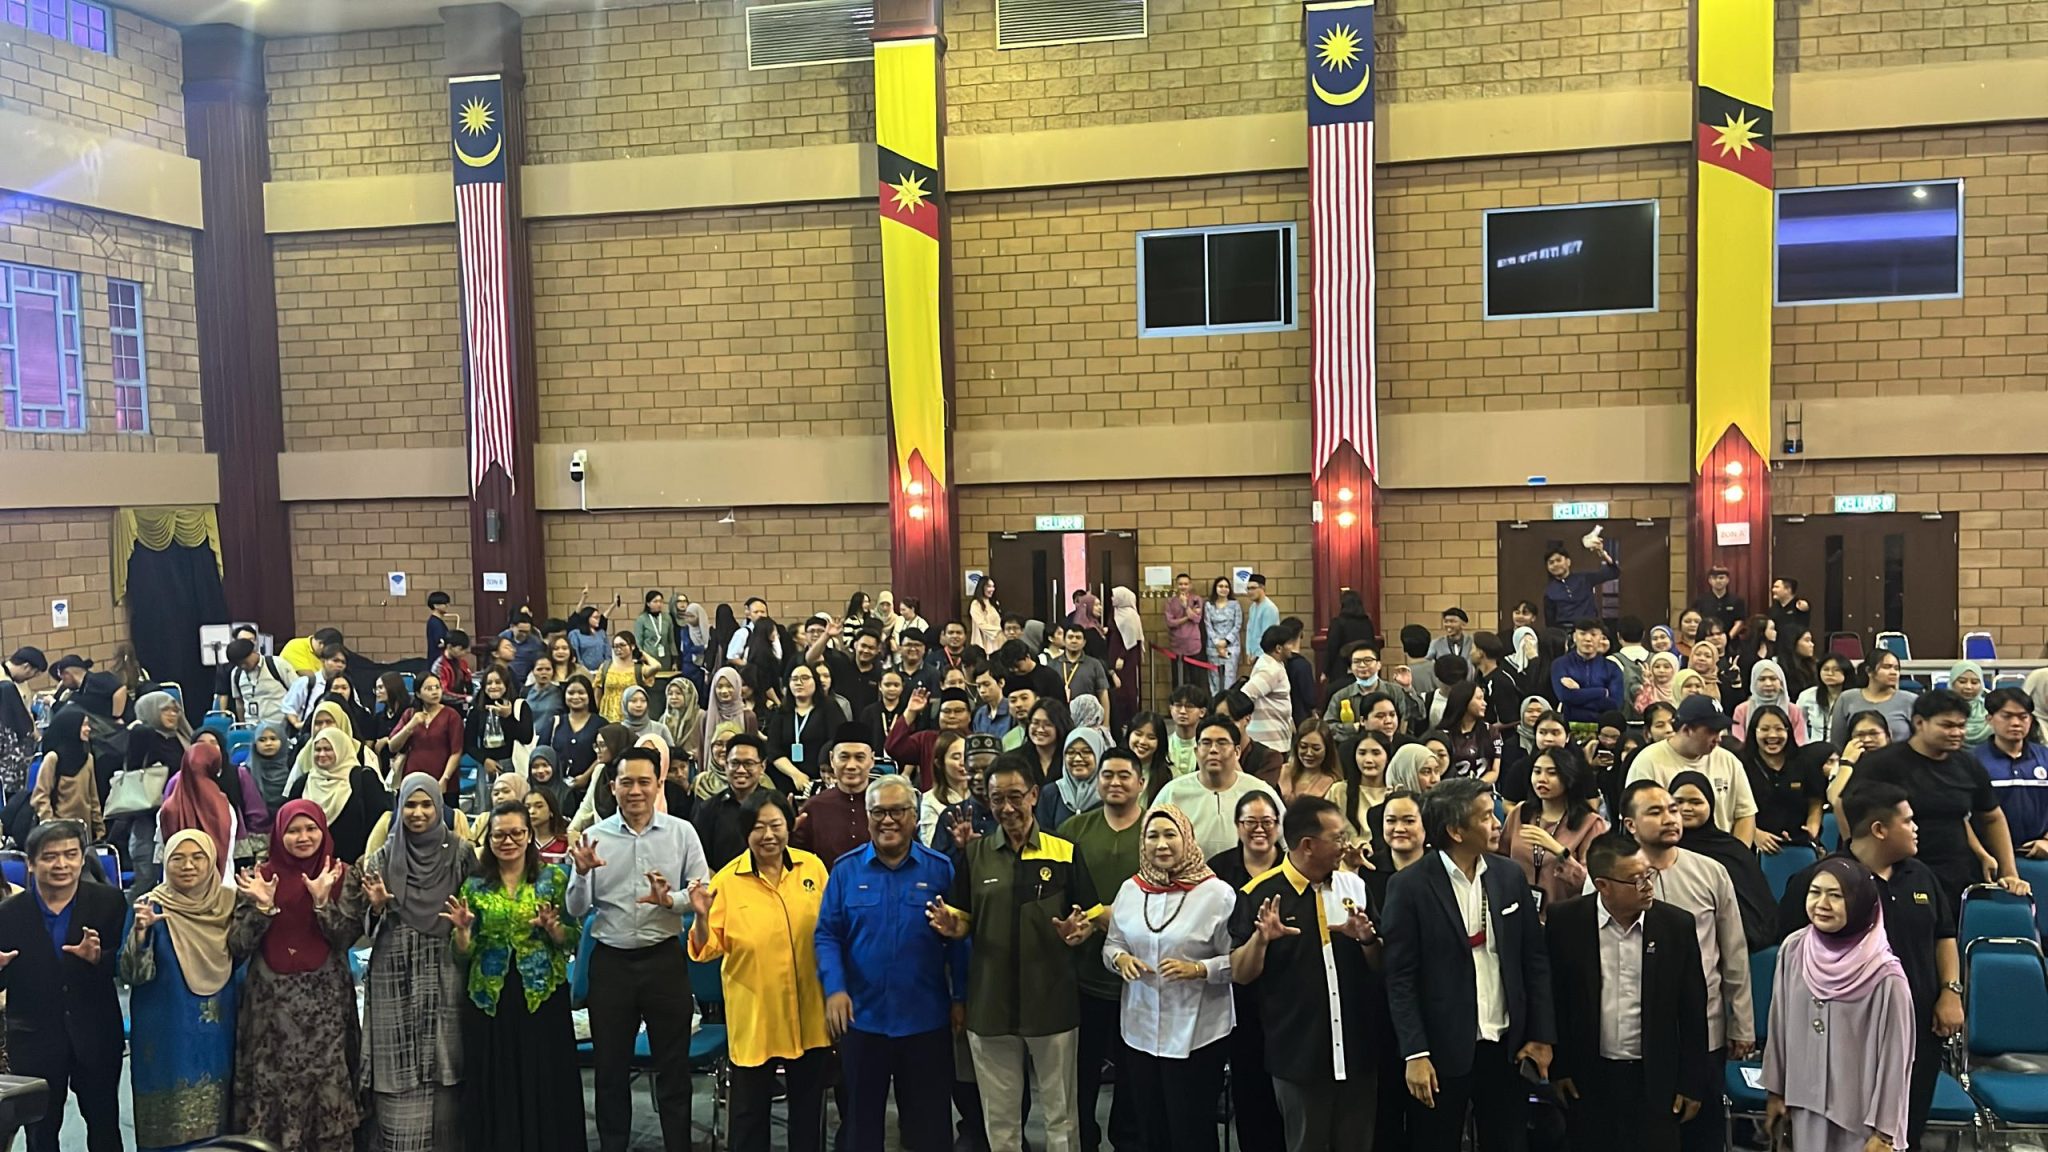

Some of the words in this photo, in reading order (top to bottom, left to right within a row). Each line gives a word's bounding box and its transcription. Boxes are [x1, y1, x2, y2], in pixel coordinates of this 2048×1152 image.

[1838, 497, 1884, 511] KELUAR
[1557, 504, 1598, 519] KELUAR
[1039, 516, 1075, 530] KELUAR
